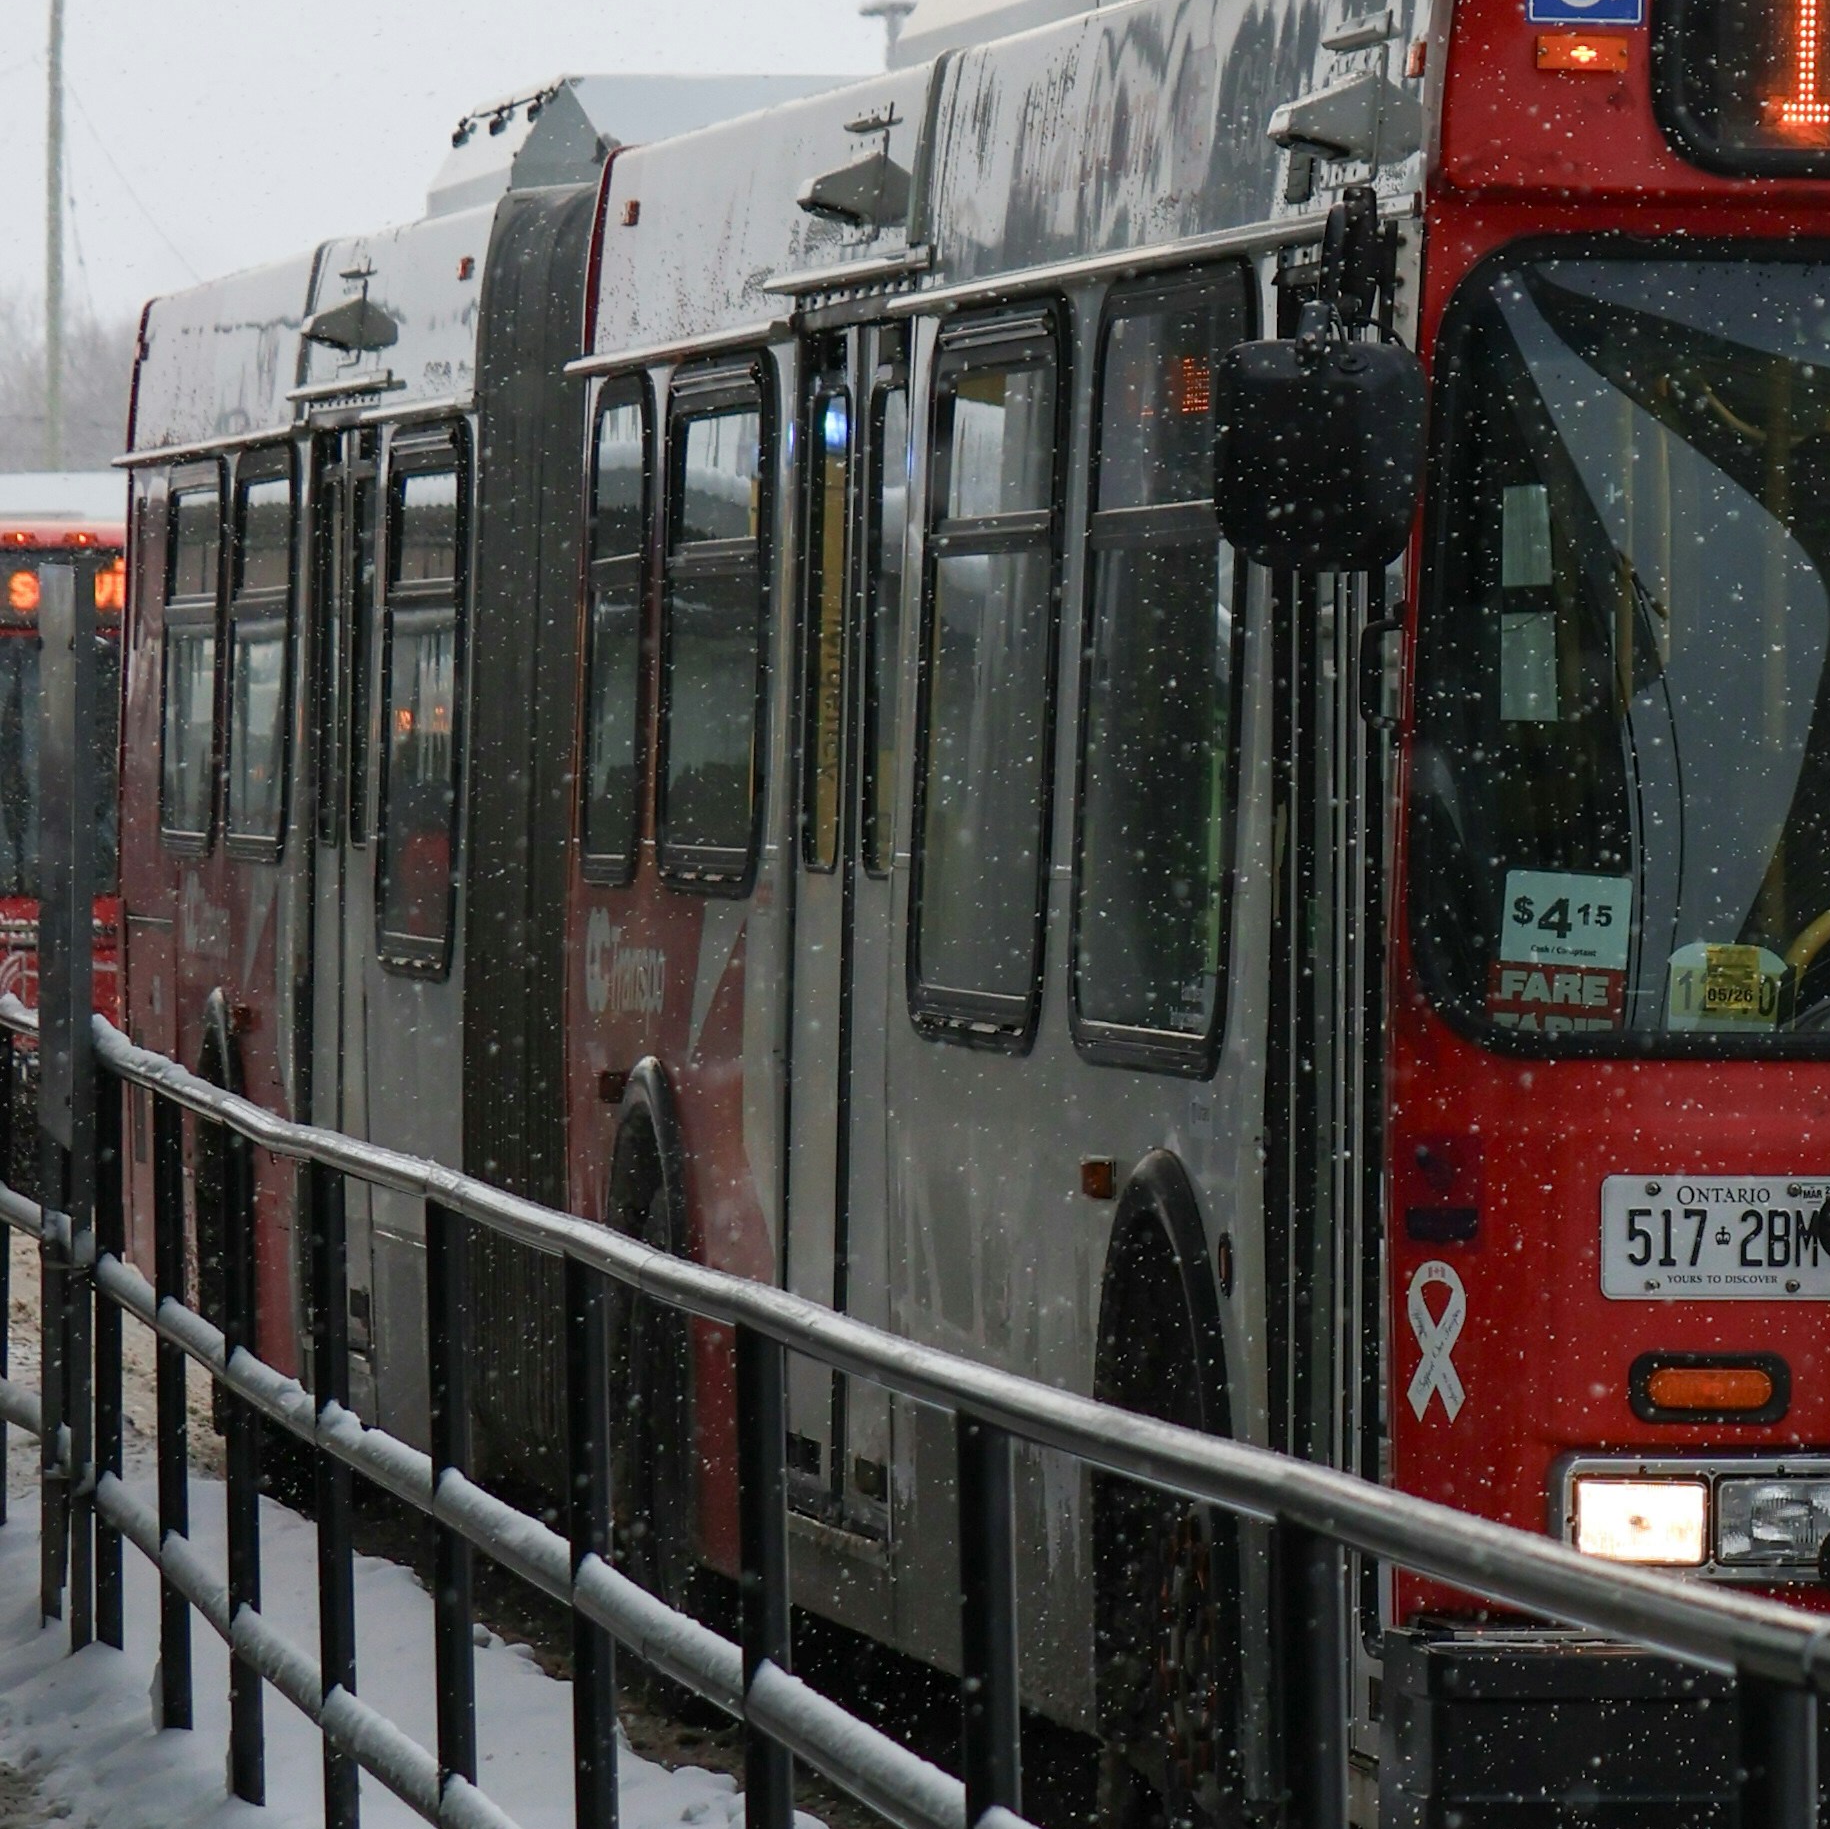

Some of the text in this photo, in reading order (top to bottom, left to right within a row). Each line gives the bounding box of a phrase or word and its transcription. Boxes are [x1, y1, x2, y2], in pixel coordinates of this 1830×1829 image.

[1501, 969, 1610, 1007] FARE
[1707, 987, 1753, 1003] 05/26
[1627, 1208, 1708, 1267] 517
[1666, 1274, 1779, 1284] YOURS TO DISCOVER
